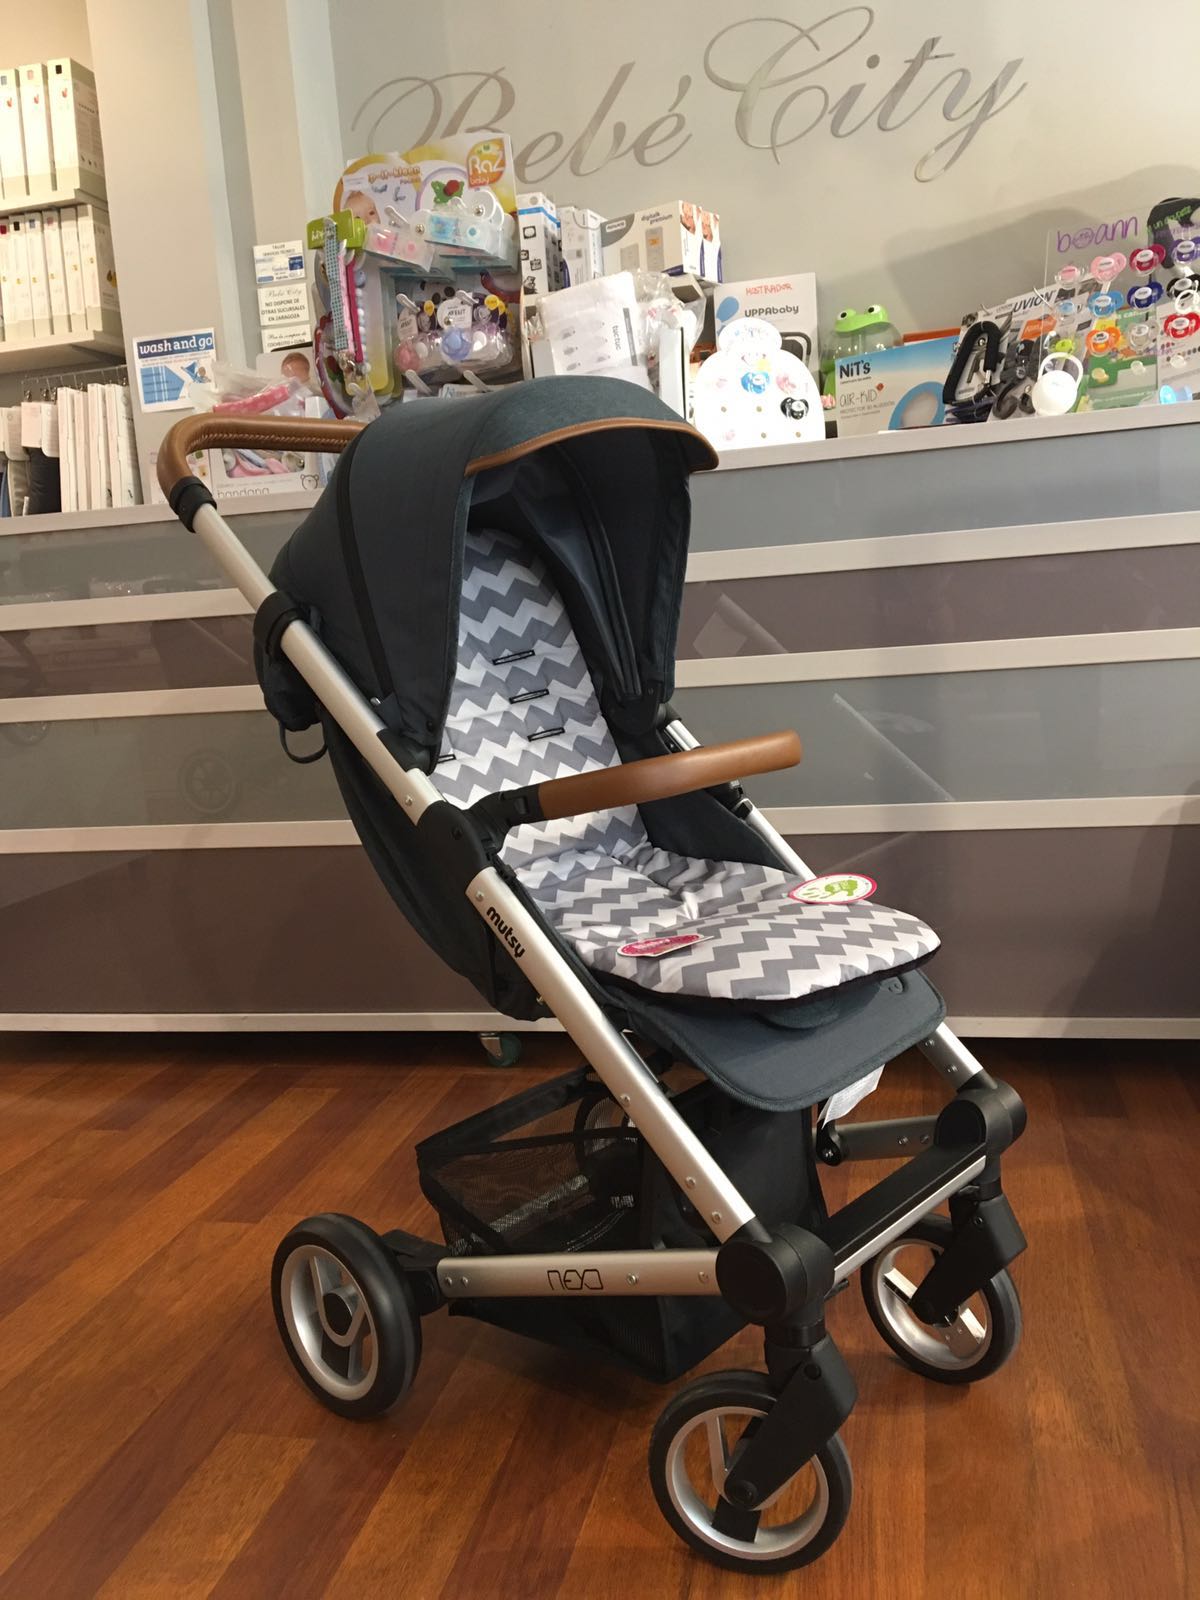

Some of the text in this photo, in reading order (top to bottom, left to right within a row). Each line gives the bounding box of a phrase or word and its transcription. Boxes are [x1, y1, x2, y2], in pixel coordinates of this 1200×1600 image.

[352, 5, 1027, 185] Bebé City
[277, 305, 306, 314] SUCURSALES
[744, 304, 800, 318] UPPAbaby
[1012, 290, 1054, 312] UVION
[139, 335, 213, 355] wash and go
[611, 324, 622, 351] tuctuc
[486, 906, 526, 958] mutsy
